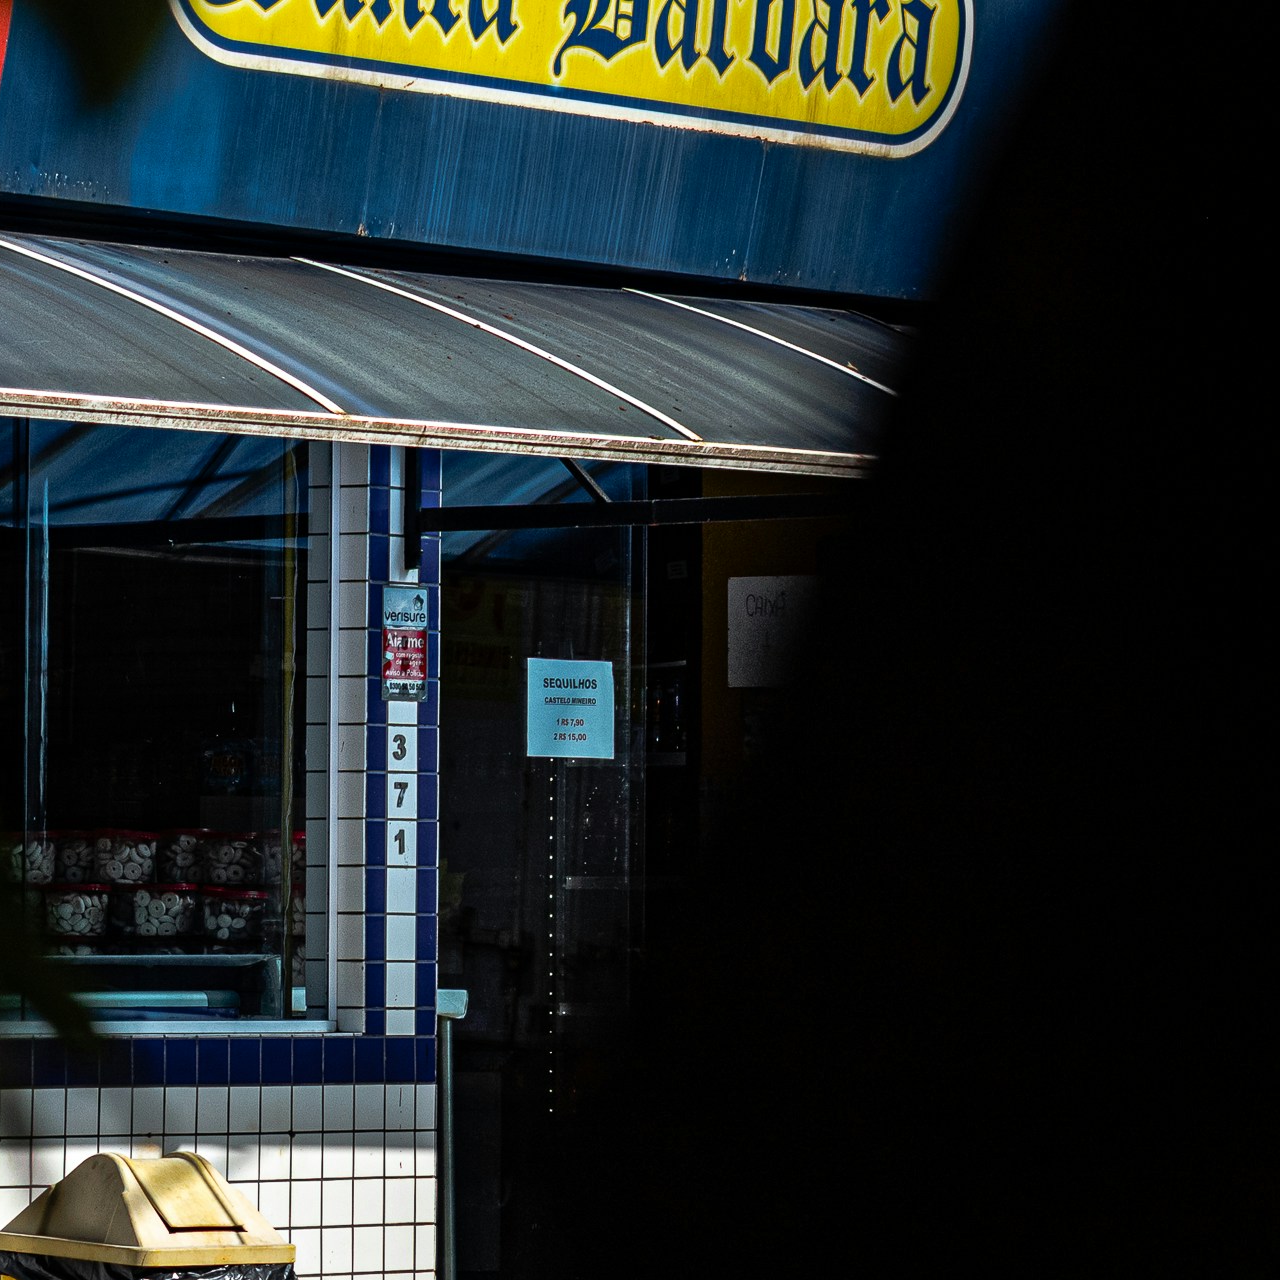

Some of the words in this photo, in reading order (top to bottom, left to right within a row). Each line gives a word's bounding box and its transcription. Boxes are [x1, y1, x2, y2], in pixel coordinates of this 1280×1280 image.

[384, 611, 426, 622] verisure
[543, 678, 597, 689] SEQUILHOS
[544, 697, 571, 705] CASTELO
[571, 697, 597, 705] MINEIRO
[570, 718, 584, 727] 7,90
[553, 732, 558, 741] 2
[568, 733, 587, 742] 15,00
